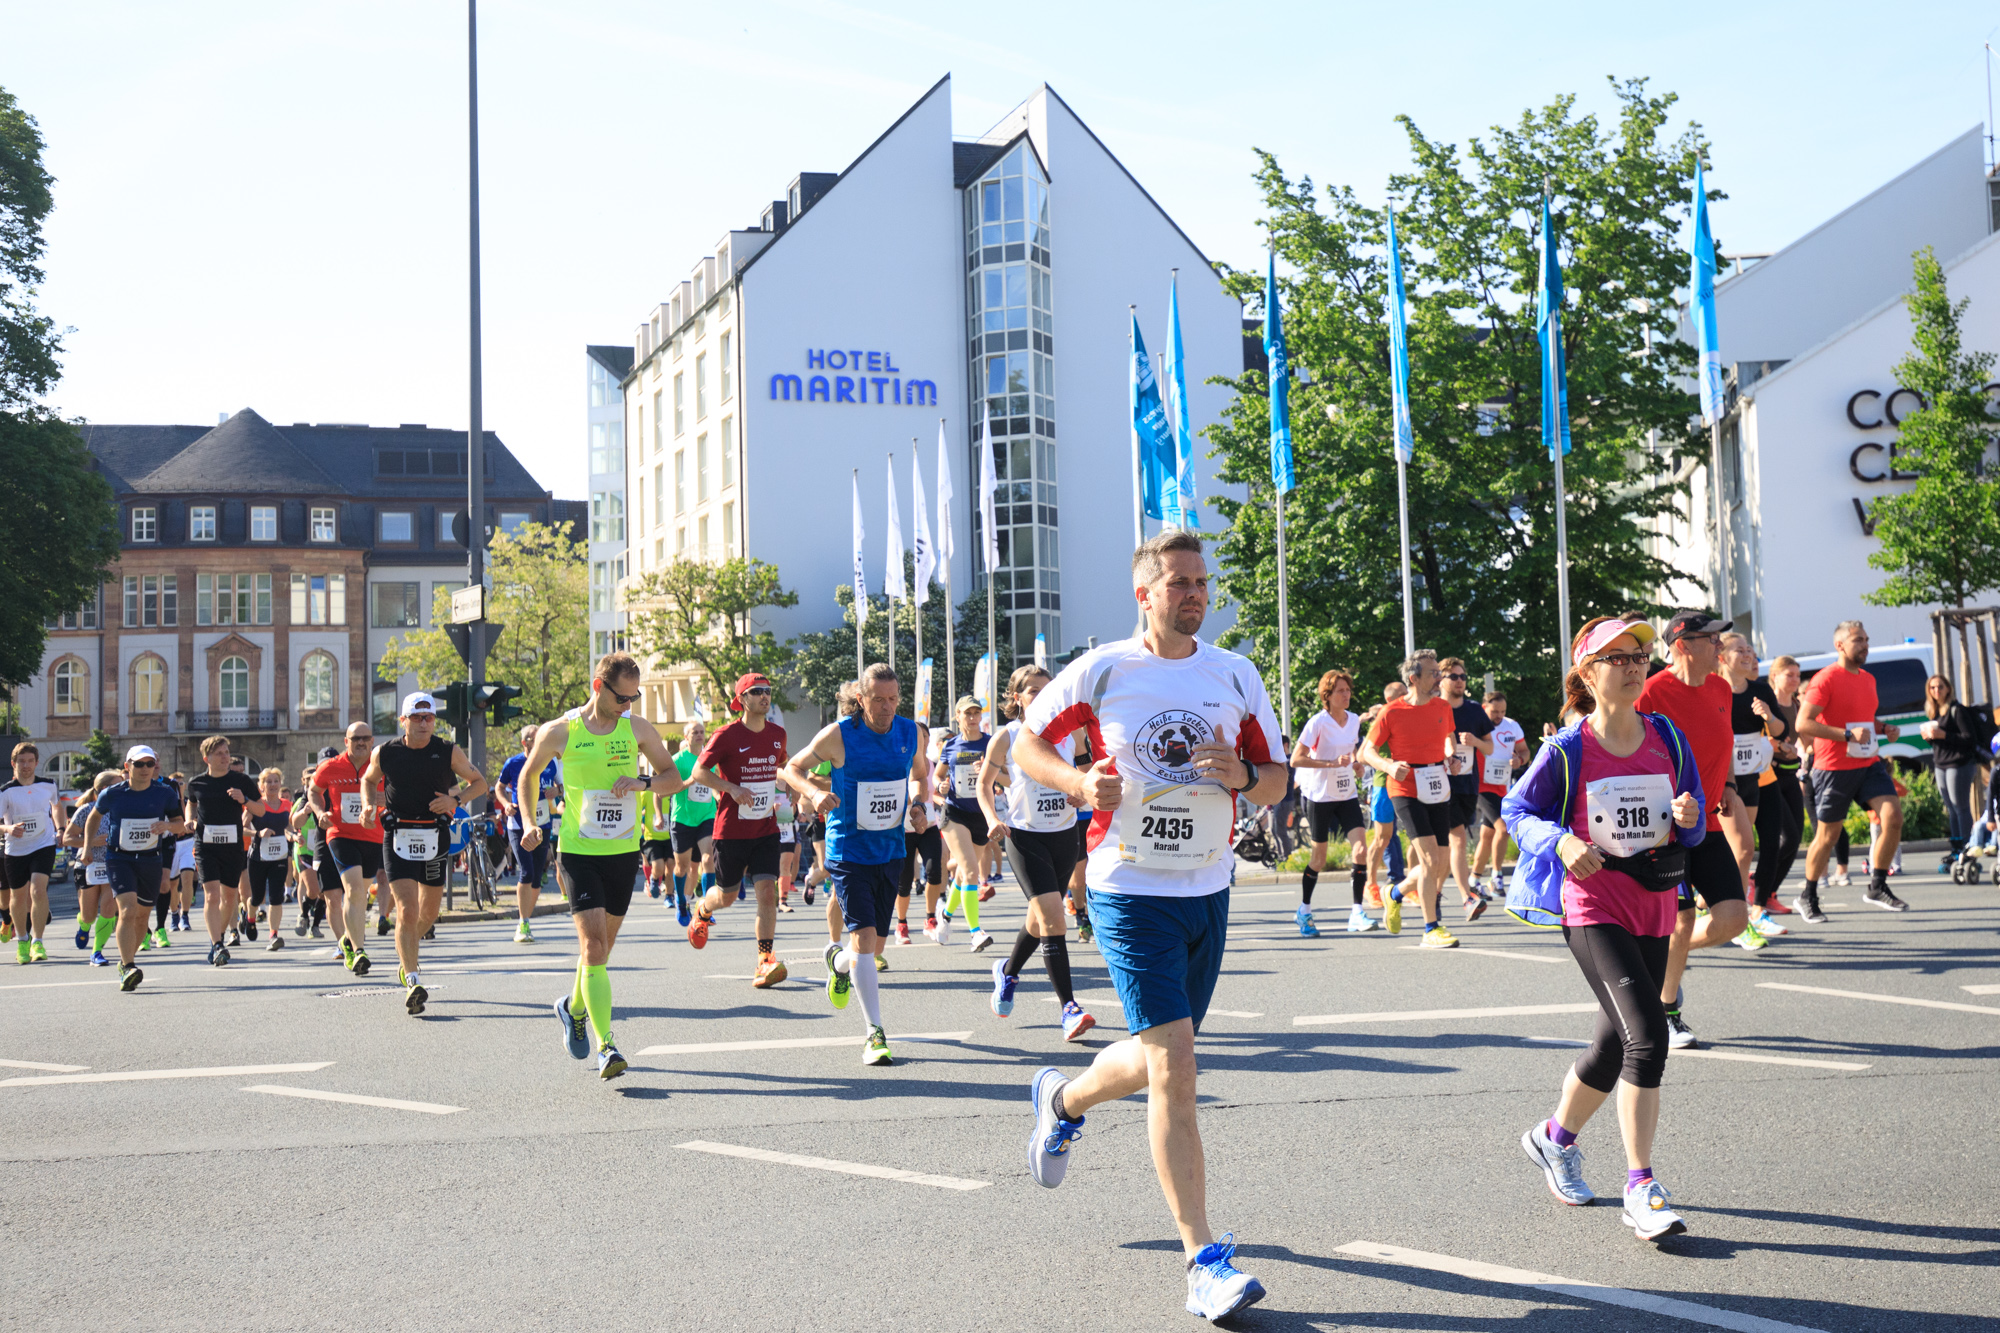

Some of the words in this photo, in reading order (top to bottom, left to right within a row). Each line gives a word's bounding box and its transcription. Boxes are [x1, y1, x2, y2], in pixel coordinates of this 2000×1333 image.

[808, 349, 900, 372] HOTEL
[770, 374, 937, 406] MARITIM
[1149, 714, 1172, 730] Heiße
[1181, 713, 1208, 736] Socken
[773, 741, 781, 749] CS
[1737, 750, 1752, 760] 810
[1429, 780, 1442, 790] 185
[869, 799, 897, 814] 2384
[1037, 798, 1065, 812] 2383
[1149, 805, 1190, 813] Halbmarathon
[596, 809, 622, 821] 1735
[1617, 807, 1649, 828] 318
[1141, 816, 1194, 840] 2435
[129, 831, 151, 840] 2396
[1612, 832, 1625, 840] Nga
[1627, 831, 1641, 839] Man
[1642, 831, 1655, 839] Amy
[408, 843, 426, 854] 156
[1153, 842, 1180, 852] Harald
